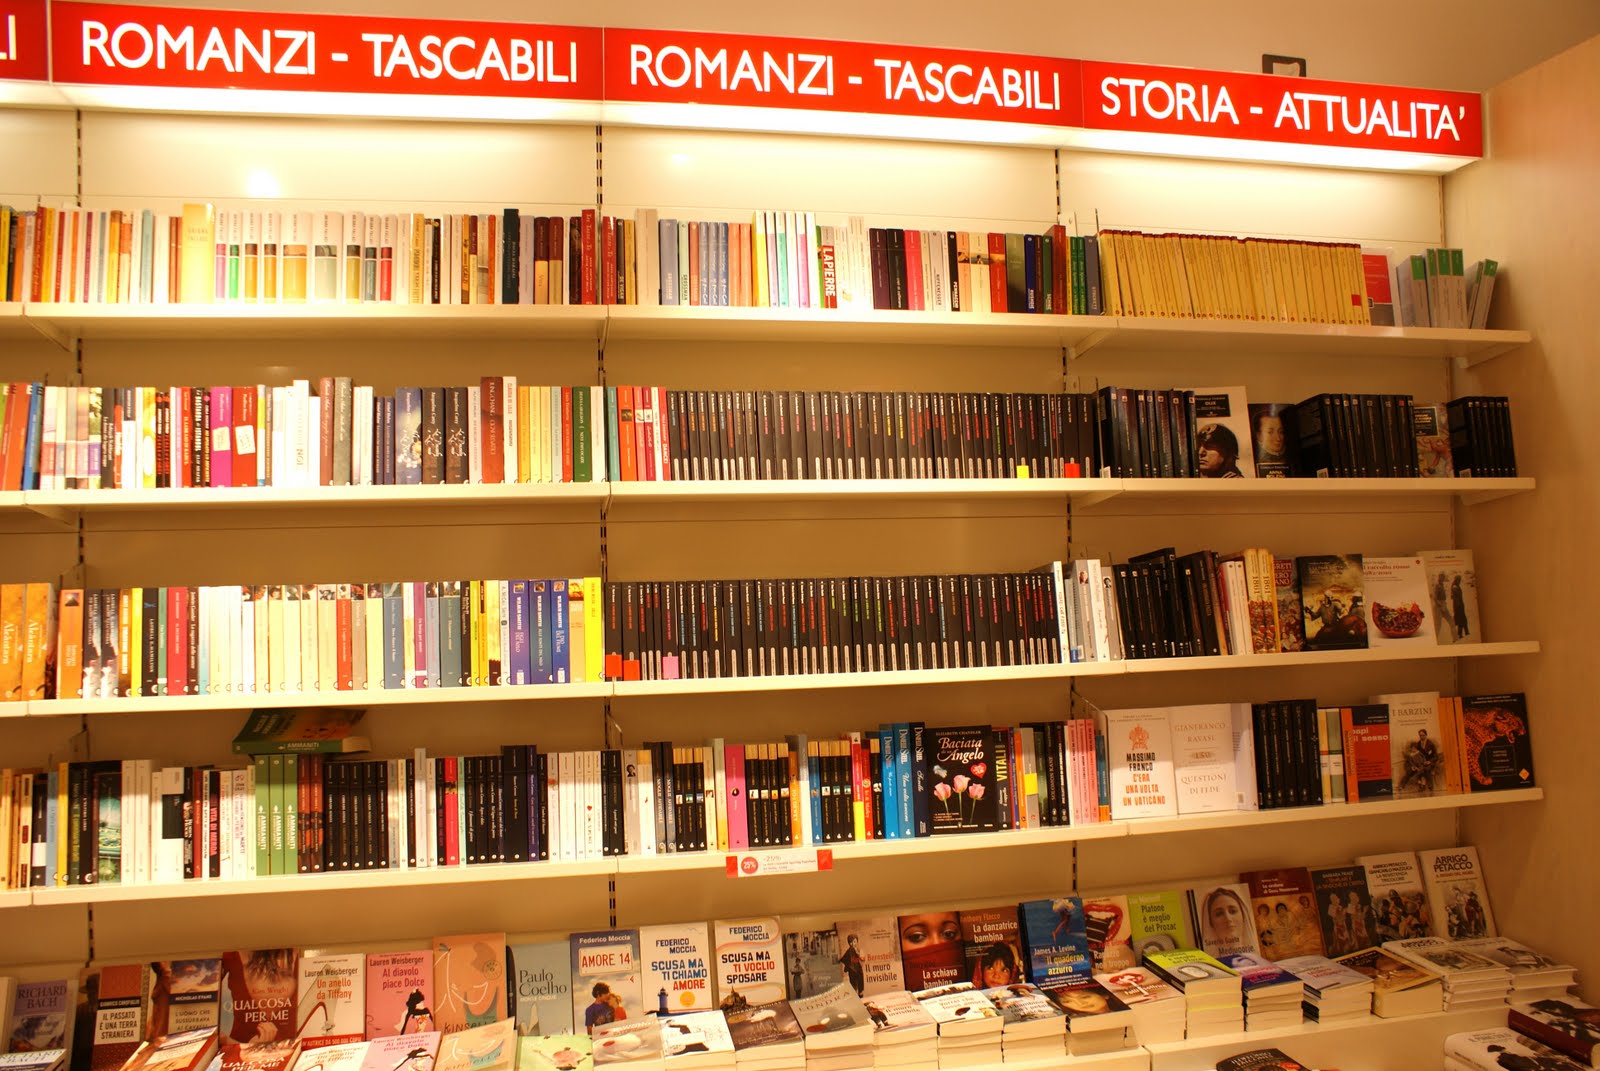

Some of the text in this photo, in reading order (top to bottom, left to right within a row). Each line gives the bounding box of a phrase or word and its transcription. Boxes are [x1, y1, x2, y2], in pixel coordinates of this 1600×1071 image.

[82, 20, 315, 75] ROMANZI
[362, 33, 577, 83] TASCABILI
[630, 44, 834, 96] ROMANZI
[874, 59, 1061, 110] TASCABILI
[1101, 77, 1239, 125] STORIA
[823, 249, 836, 297] LAPIERRE
[1397, 707, 1432, 717] BARZINI
[1174, 722, 1226, 732] GIANFRANCO
[938, 737, 983, 749] Baciata
[1187, 735, 1215, 743] RAVASI
[1362, 734, 1389, 742] sesso
[937, 748, 984, 764] Angelo
[1126, 752, 1156, 763] MASSIMO
[1129, 762, 1153, 772] FRANCO
[1132, 773, 1151, 783] C'ERA
[1181, 773, 1227, 785] QUESTIONI
[1125, 783, 1159, 794] UNA VOLTA
[1122, 795, 1166, 806] UN VATICANO
[1435, 853, 1469, 865] ARRIGO
[1433, 862, 1473, 873] PETACCO
[1141, 904, 1165, 914] Platone
[973, 920, 1018, 932] La danzatrice
[1148, 914, 1171, 926] meglio
[729, 925, 763, 935] FEDERICO
[1144, 923, 1177, 933] del Prozac
[579, 934, 631, 944] Federico Moccia
[742, 932, 770, 941] MOCCIA
[974, 932, 1003, 943] bambina
[656, 938, 690, 948] FEDERICO
[669, 945, 697, 954] MOCCIA
[1034, 947, 1051, 956] James
[1058, 944, 1076, 953] Levine
[369, 955, 425, 968] Lauren Weisberger
[581, 952, 631, 969] AMORE 14
[721, 951, 771, 964] SCUSA MA
[1053, 954, 1085, 966] quaderno
[651, 958, 704, 972] SCUSA MA
[733, 961, 775, 973] TI VOGLIO
[865, 963, 891, 973] Il muro
[1048, 965, 1073, 976] azzurro
[304, 966, 359, 978] Lauren Weisberger
[382, 966, 419, 977] Al diavolo
[519, 969, 554, 984] Paulo
[662, 968, 708, 981] TI CHIAMO
[922, 967, 958, 979] La schiava
[316, 976, 352, 988] Un anello
[382, 977, 425, 990] piace Dolce
[726, 972, 768, 984] SPOSARE
[866, 972, 898, 984] invisibile
[519, 982, 568, 998] Coelho
[673, 979, 706, 991] AMORE
[18, 985, 68, 1000] RICHARD
[316, 987, 352, 1001] da Tiffany
[26, 996, 58, 1009] BACH
[223, 997, 292, 1013] QUALCOSA
[102, 1010, 136, 1021] IL PASSATO
[175, 1010, 198, 1018] L'UOMO
[245, 1009, 289, 1023] PER ME
[105, 1019, 138, 1029] UNA TERRA
[101, 1029, 135, 1040] STRANIERA
